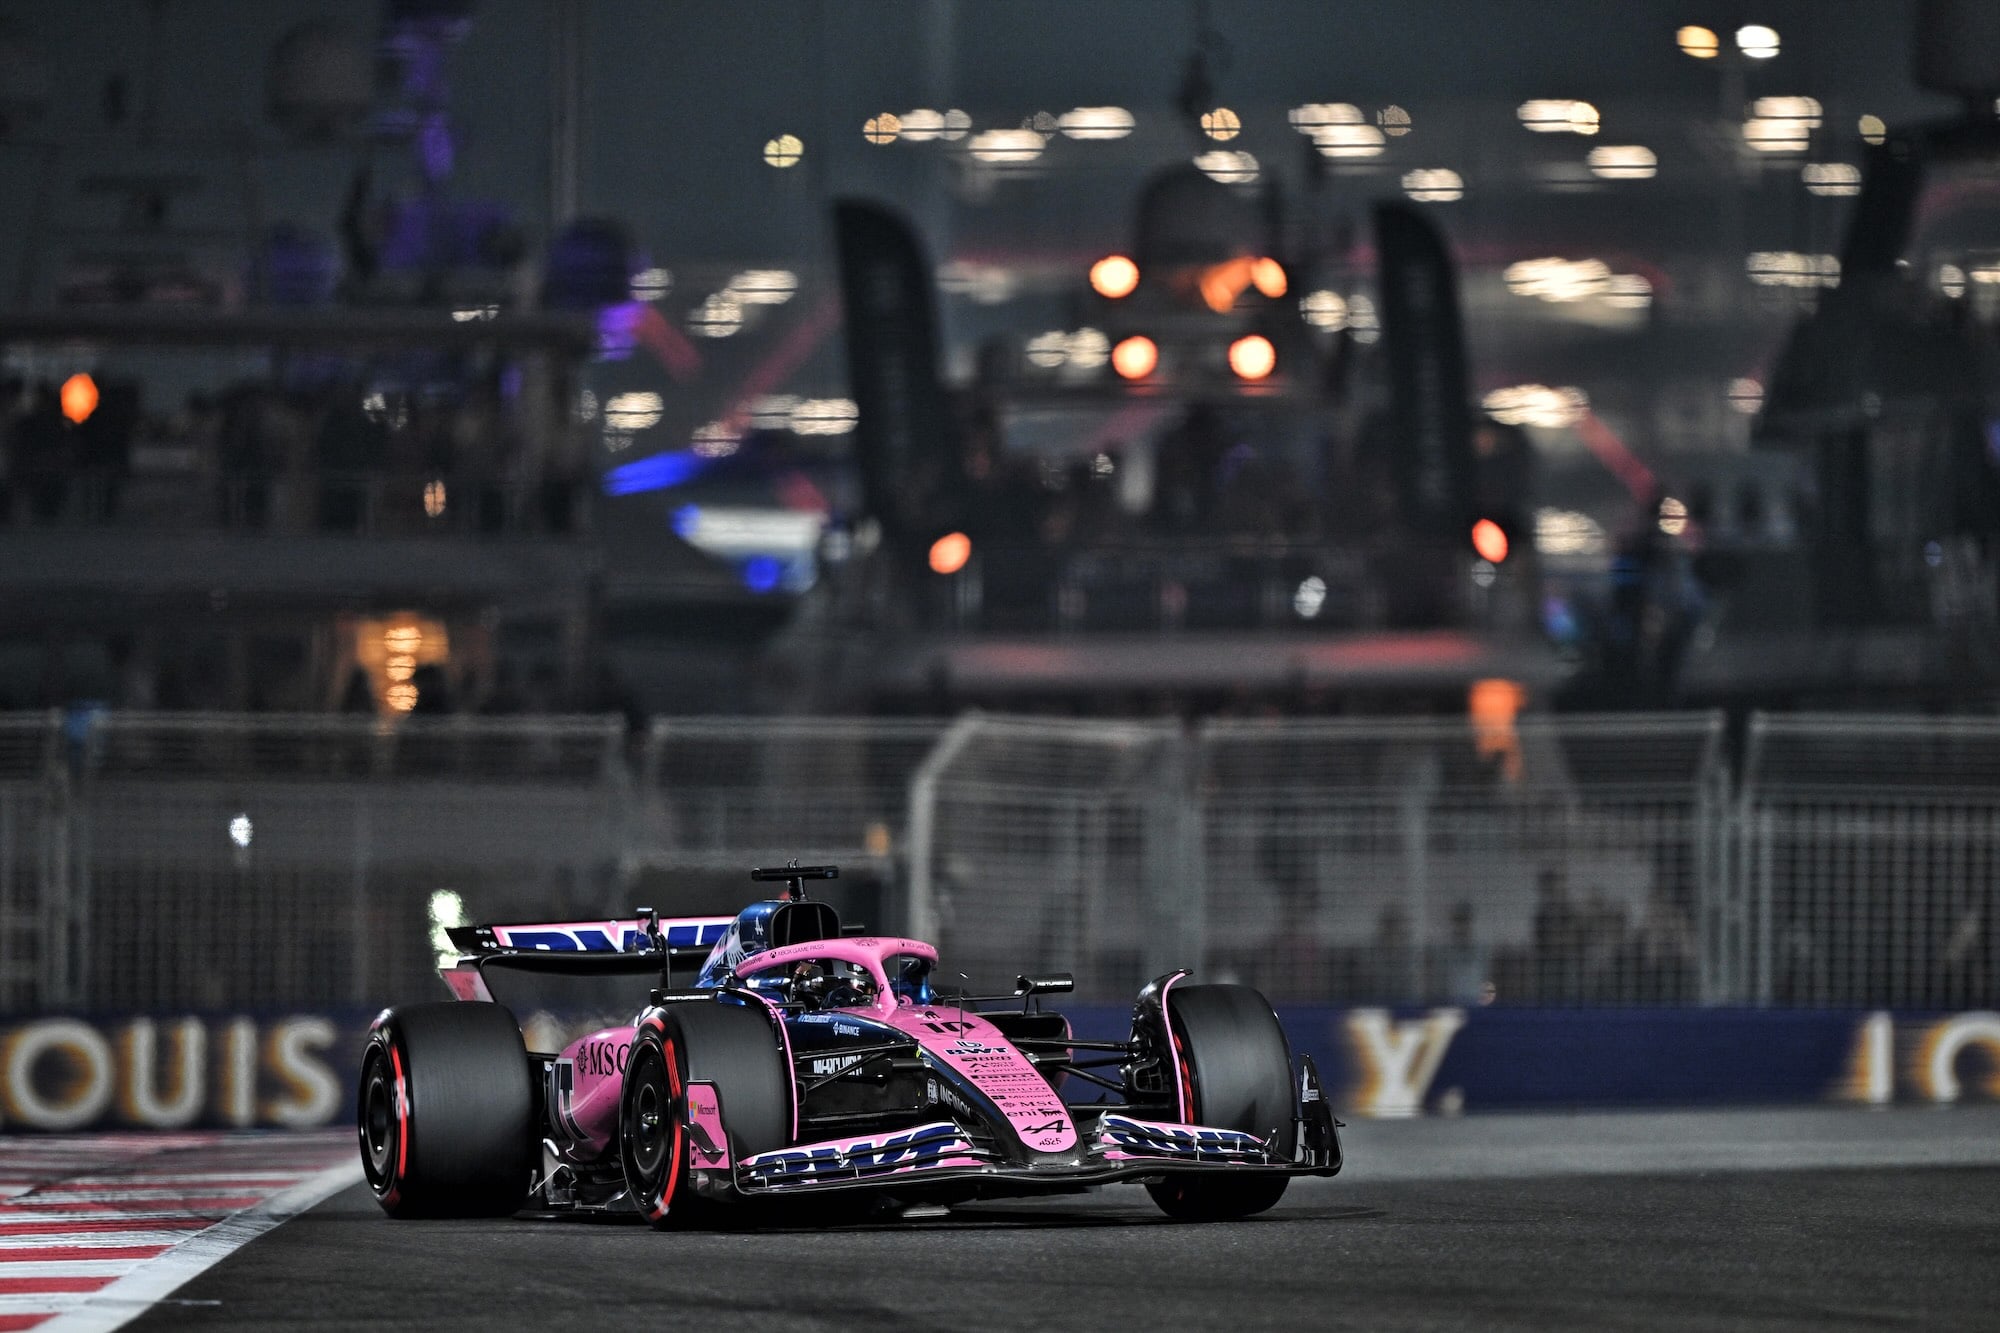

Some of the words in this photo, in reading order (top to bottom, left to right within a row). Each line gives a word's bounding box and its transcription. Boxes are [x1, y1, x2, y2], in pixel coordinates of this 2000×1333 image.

[920, 1021, 976, 1034] 10
[945, 1047, 1007, 1056] BWT
[589, 1042, 630, 1076] MSC
[1006, 1109, 1037, 1117] eni
